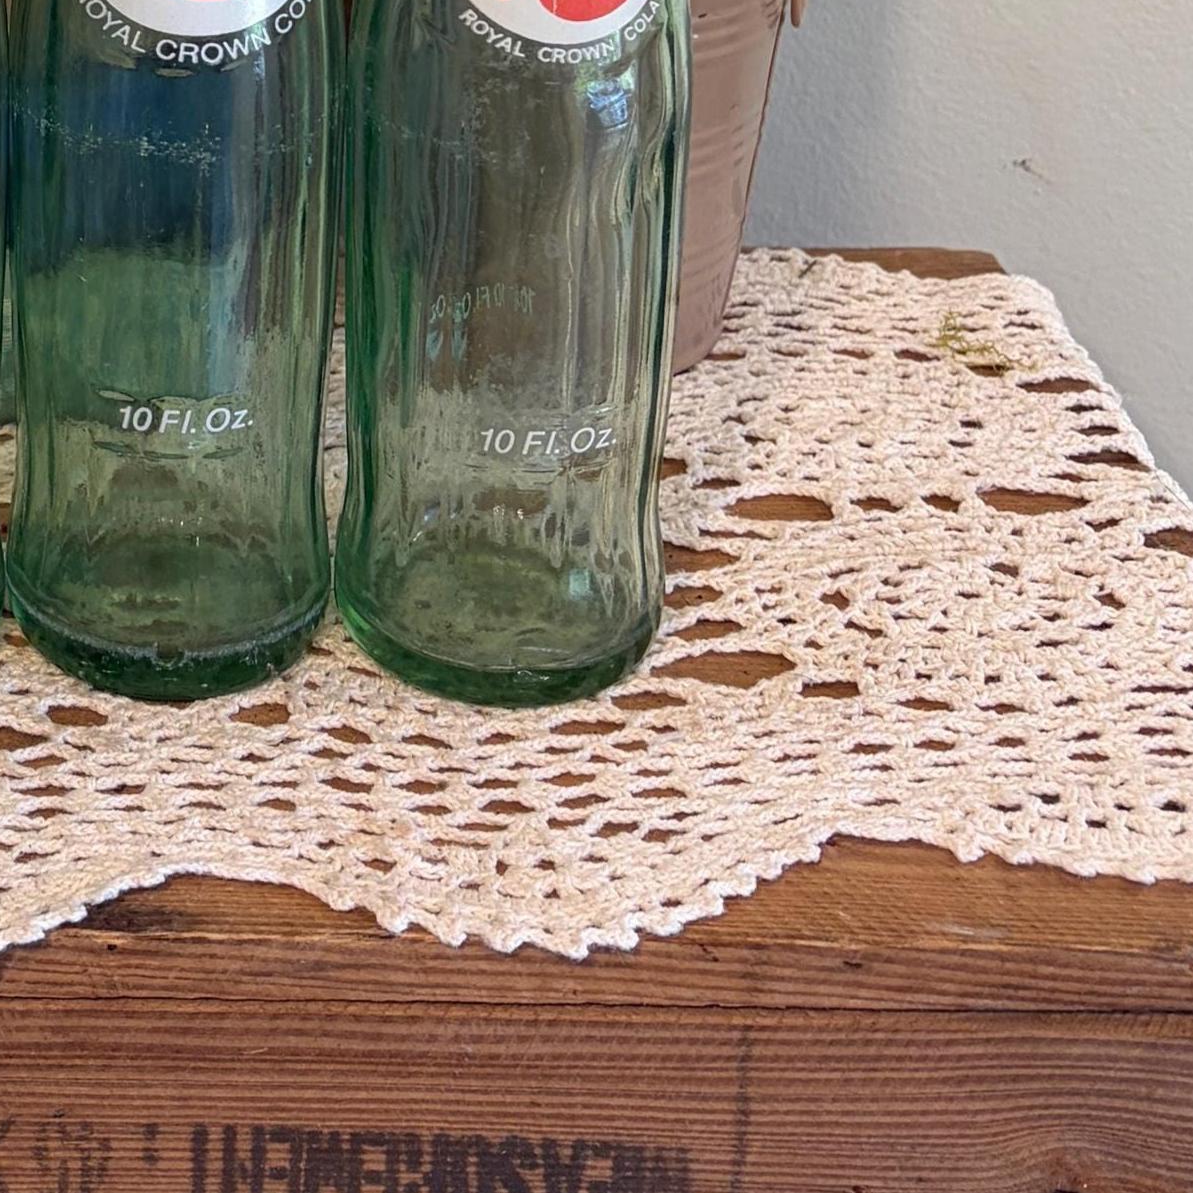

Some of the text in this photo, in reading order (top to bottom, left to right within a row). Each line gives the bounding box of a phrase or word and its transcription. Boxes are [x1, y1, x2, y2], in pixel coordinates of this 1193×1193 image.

[155, 31, 271, 64] CROWN
[458, 0, 661, 64] ROYAL CROWN COLA
[119, 405, 152, 431] 10
[206, 407, 254, 434] Oz.
[480, 428, 515, 454] 10
[570, 427, 617, 454] Oz.
